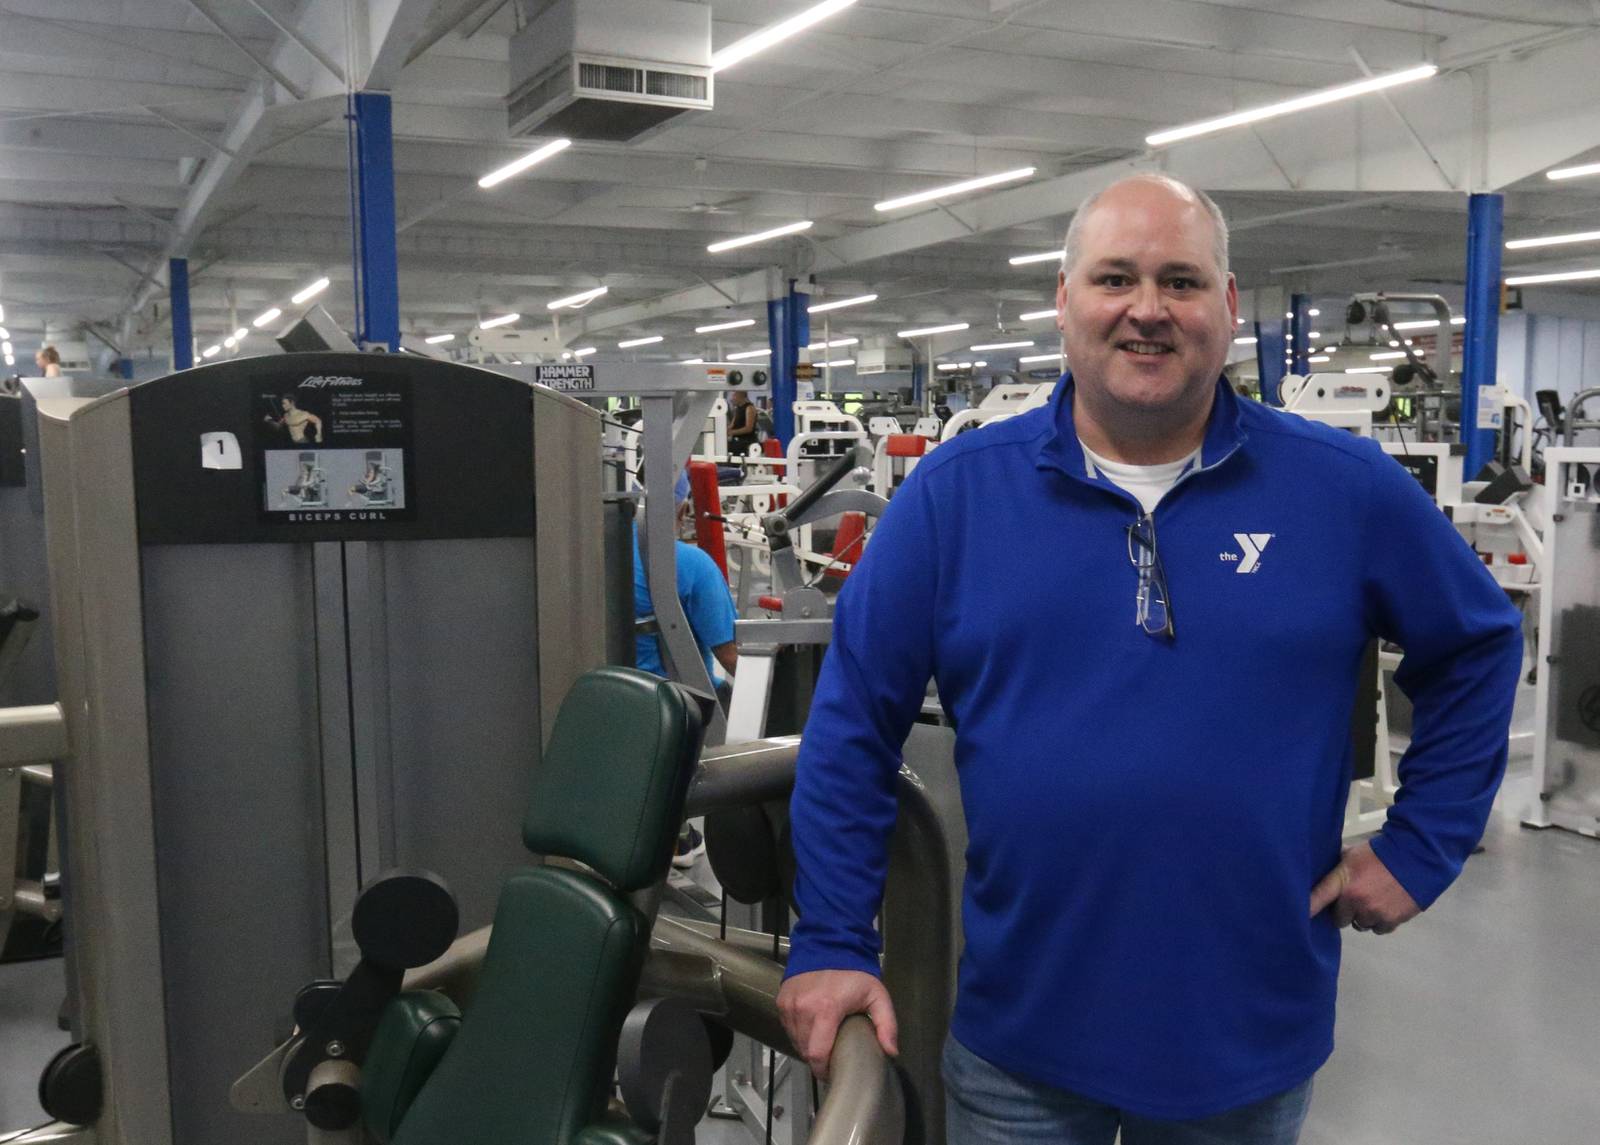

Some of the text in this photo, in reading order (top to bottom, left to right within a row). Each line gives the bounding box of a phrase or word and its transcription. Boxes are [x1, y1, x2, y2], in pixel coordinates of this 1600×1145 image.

[540, 366, 590, 378] HAMMER
[217, 439, 224, 455] 1
[289, 512, 386, 521] BICEPS CURL
[1219, 552, 1238, 561] the
[1233, 533, 1272, 573] Y
